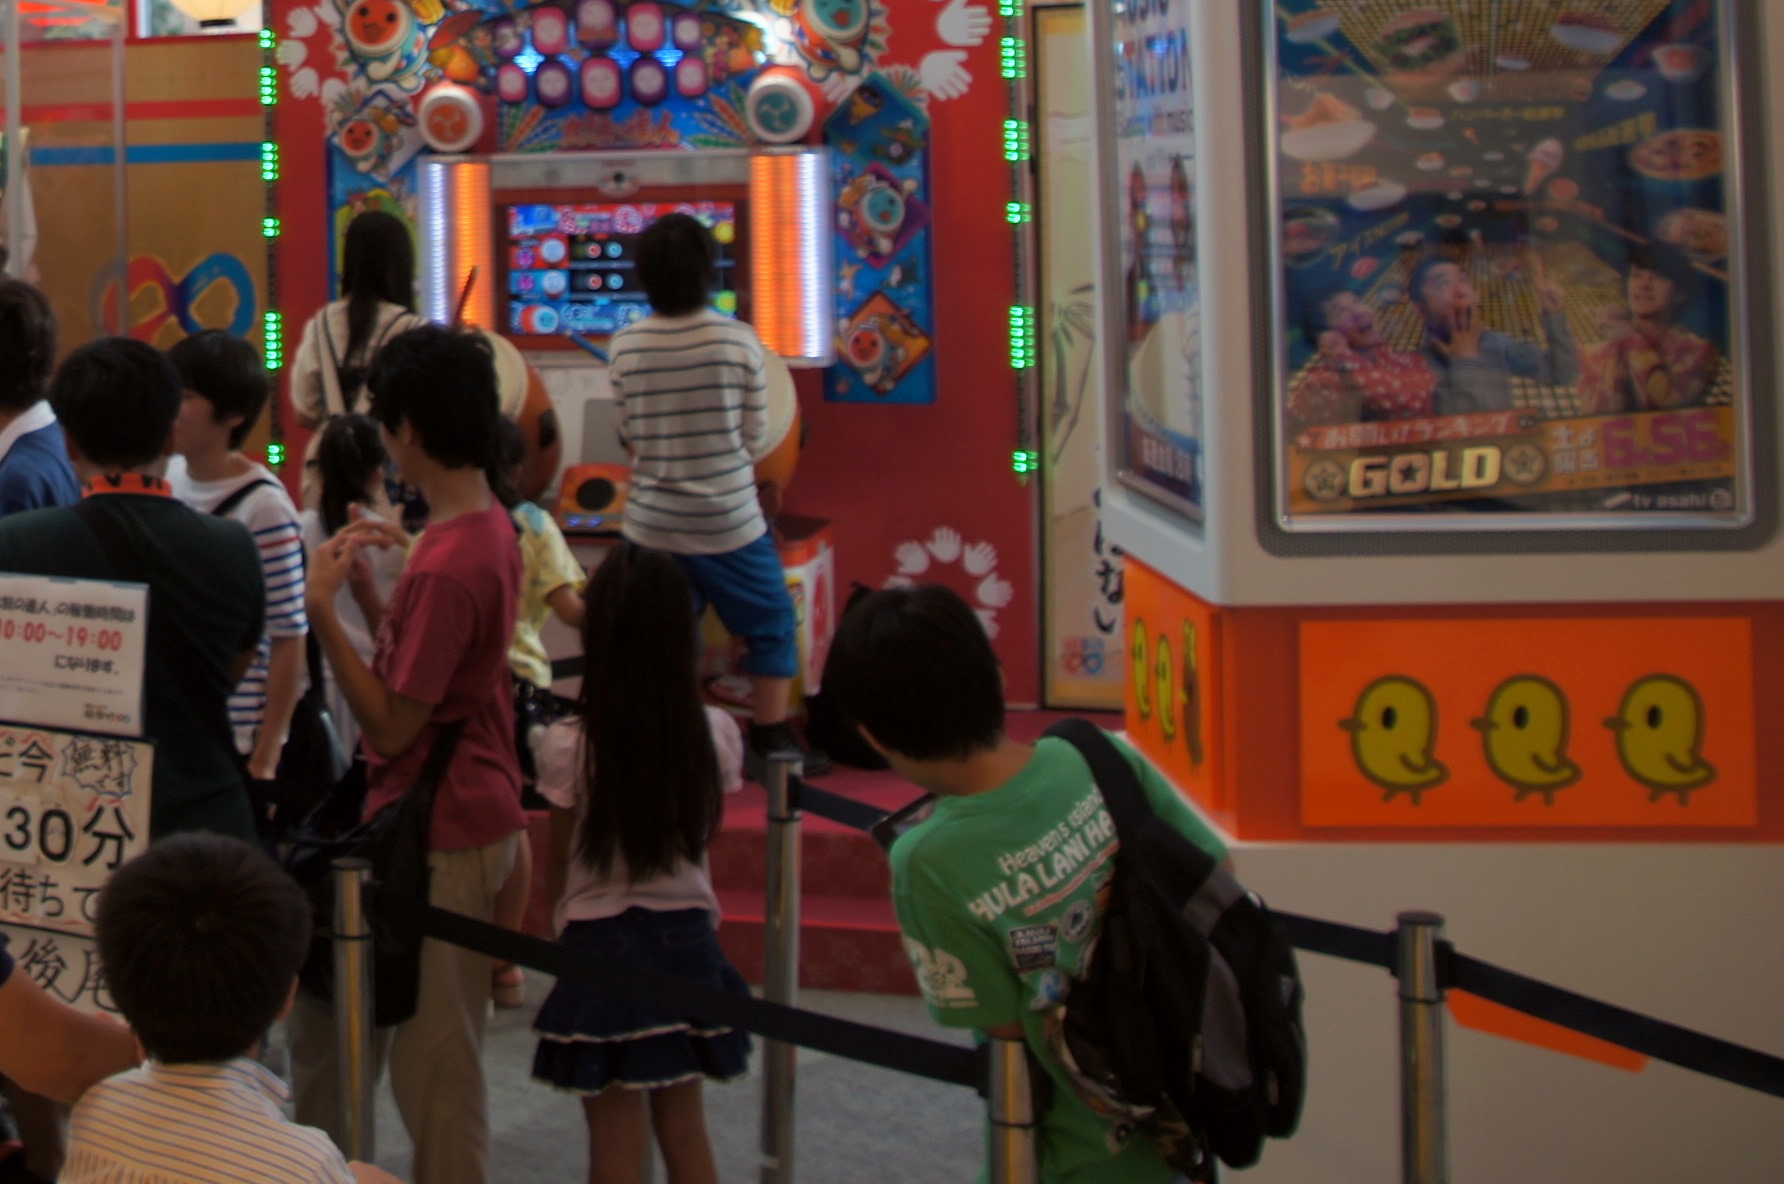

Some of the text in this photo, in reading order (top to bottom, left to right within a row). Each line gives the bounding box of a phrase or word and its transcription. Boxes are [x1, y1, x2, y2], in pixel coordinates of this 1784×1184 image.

[1349, 445, 1502, 498] GOLD
[4, 804, 136, 869] 30分
[968, 871, 1041, 923] HULA
[1037, 833, 1091, 889] LANI
